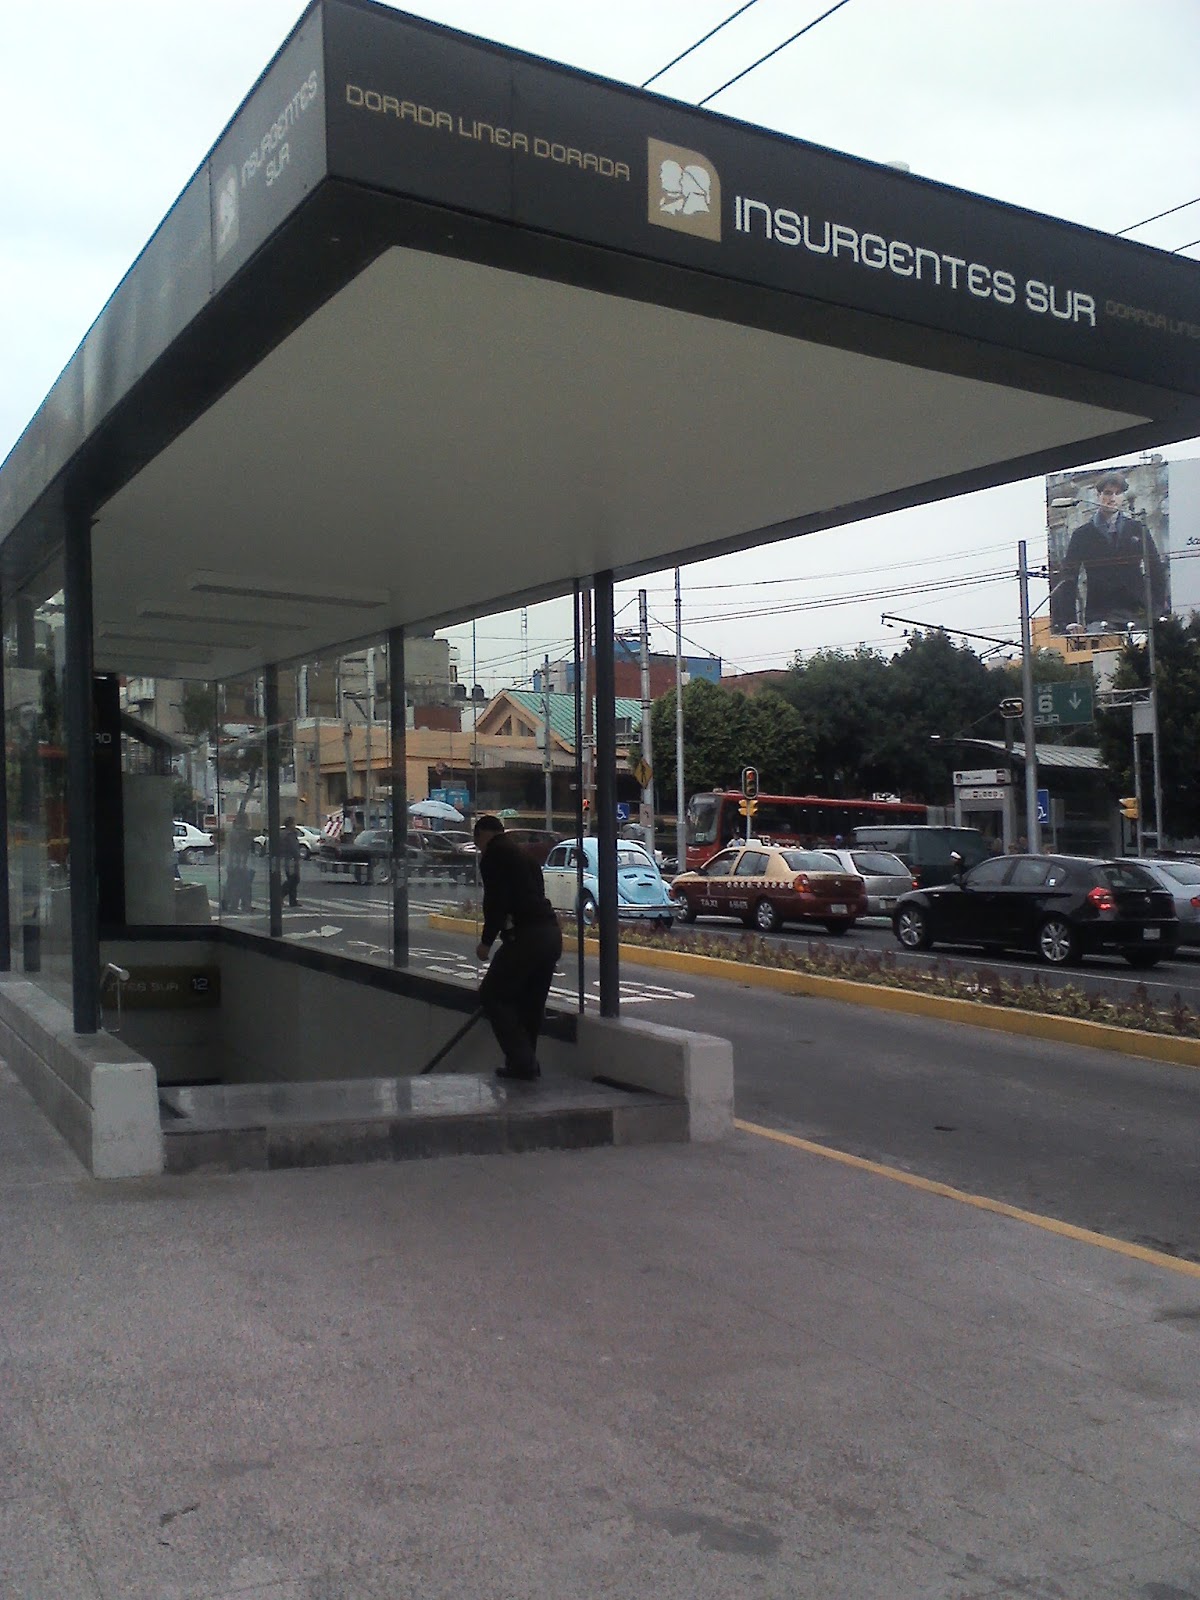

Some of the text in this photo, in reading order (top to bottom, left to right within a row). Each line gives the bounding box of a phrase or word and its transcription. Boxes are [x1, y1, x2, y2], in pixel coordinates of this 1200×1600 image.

[346, 84, 631, 182] DORADA LINEA DORADA
[735, 195, 1097, 327] INSURGENTES SUR
[1038, 694, 1054, 713] 6
[1034, 714, 1060, 726] SUR
[700, 898, 719, 909] TAXI
[192, 977, 209, 991] 12
